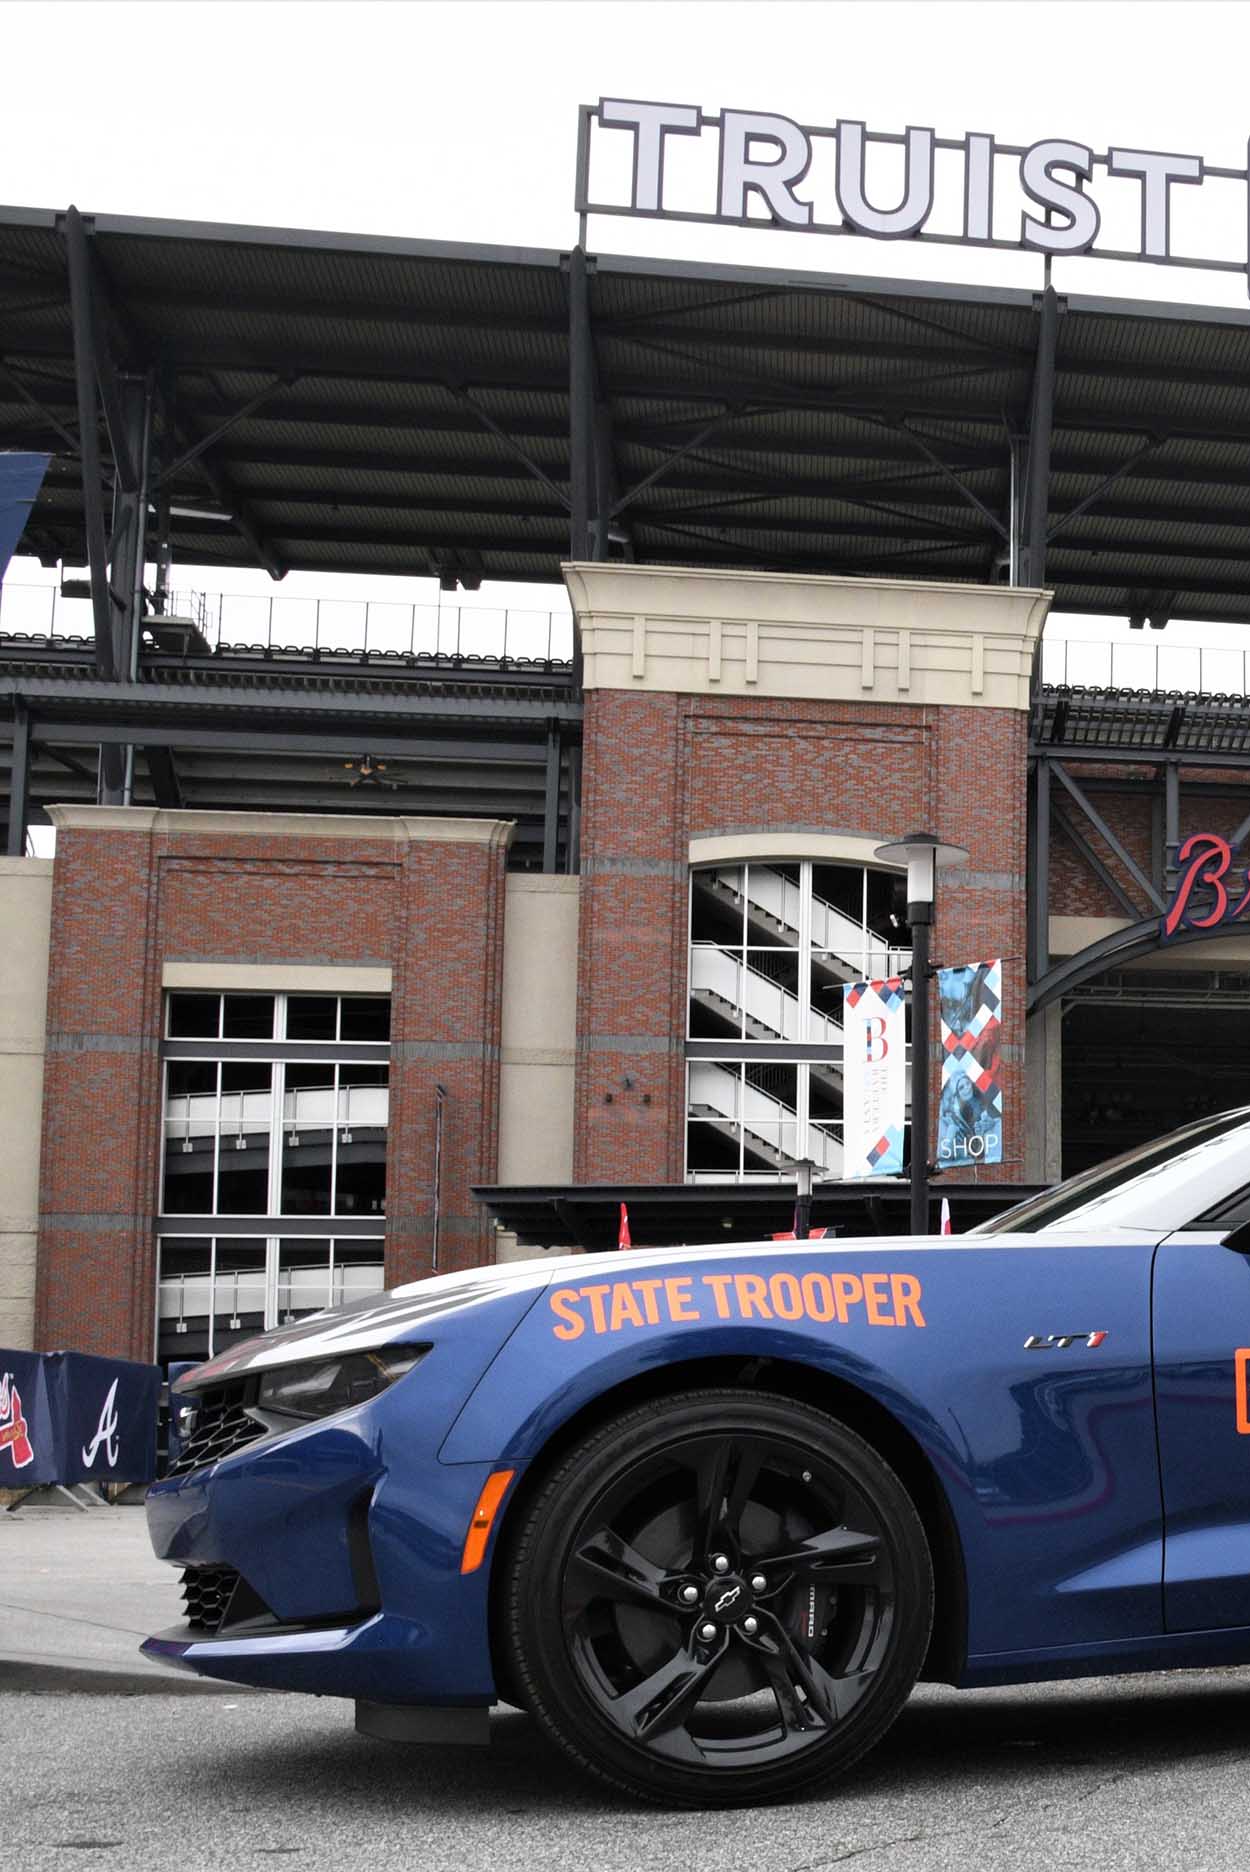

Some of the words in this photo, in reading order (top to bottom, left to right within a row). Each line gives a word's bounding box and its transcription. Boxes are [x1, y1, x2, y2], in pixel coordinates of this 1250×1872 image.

[599, 97, 1204, 256] TRUIST
[940, 1134, 999, 1159] SHOP
[550, 1276, 700, 1341] STATE
[702, 1272, 927, 1328] TROOPER
